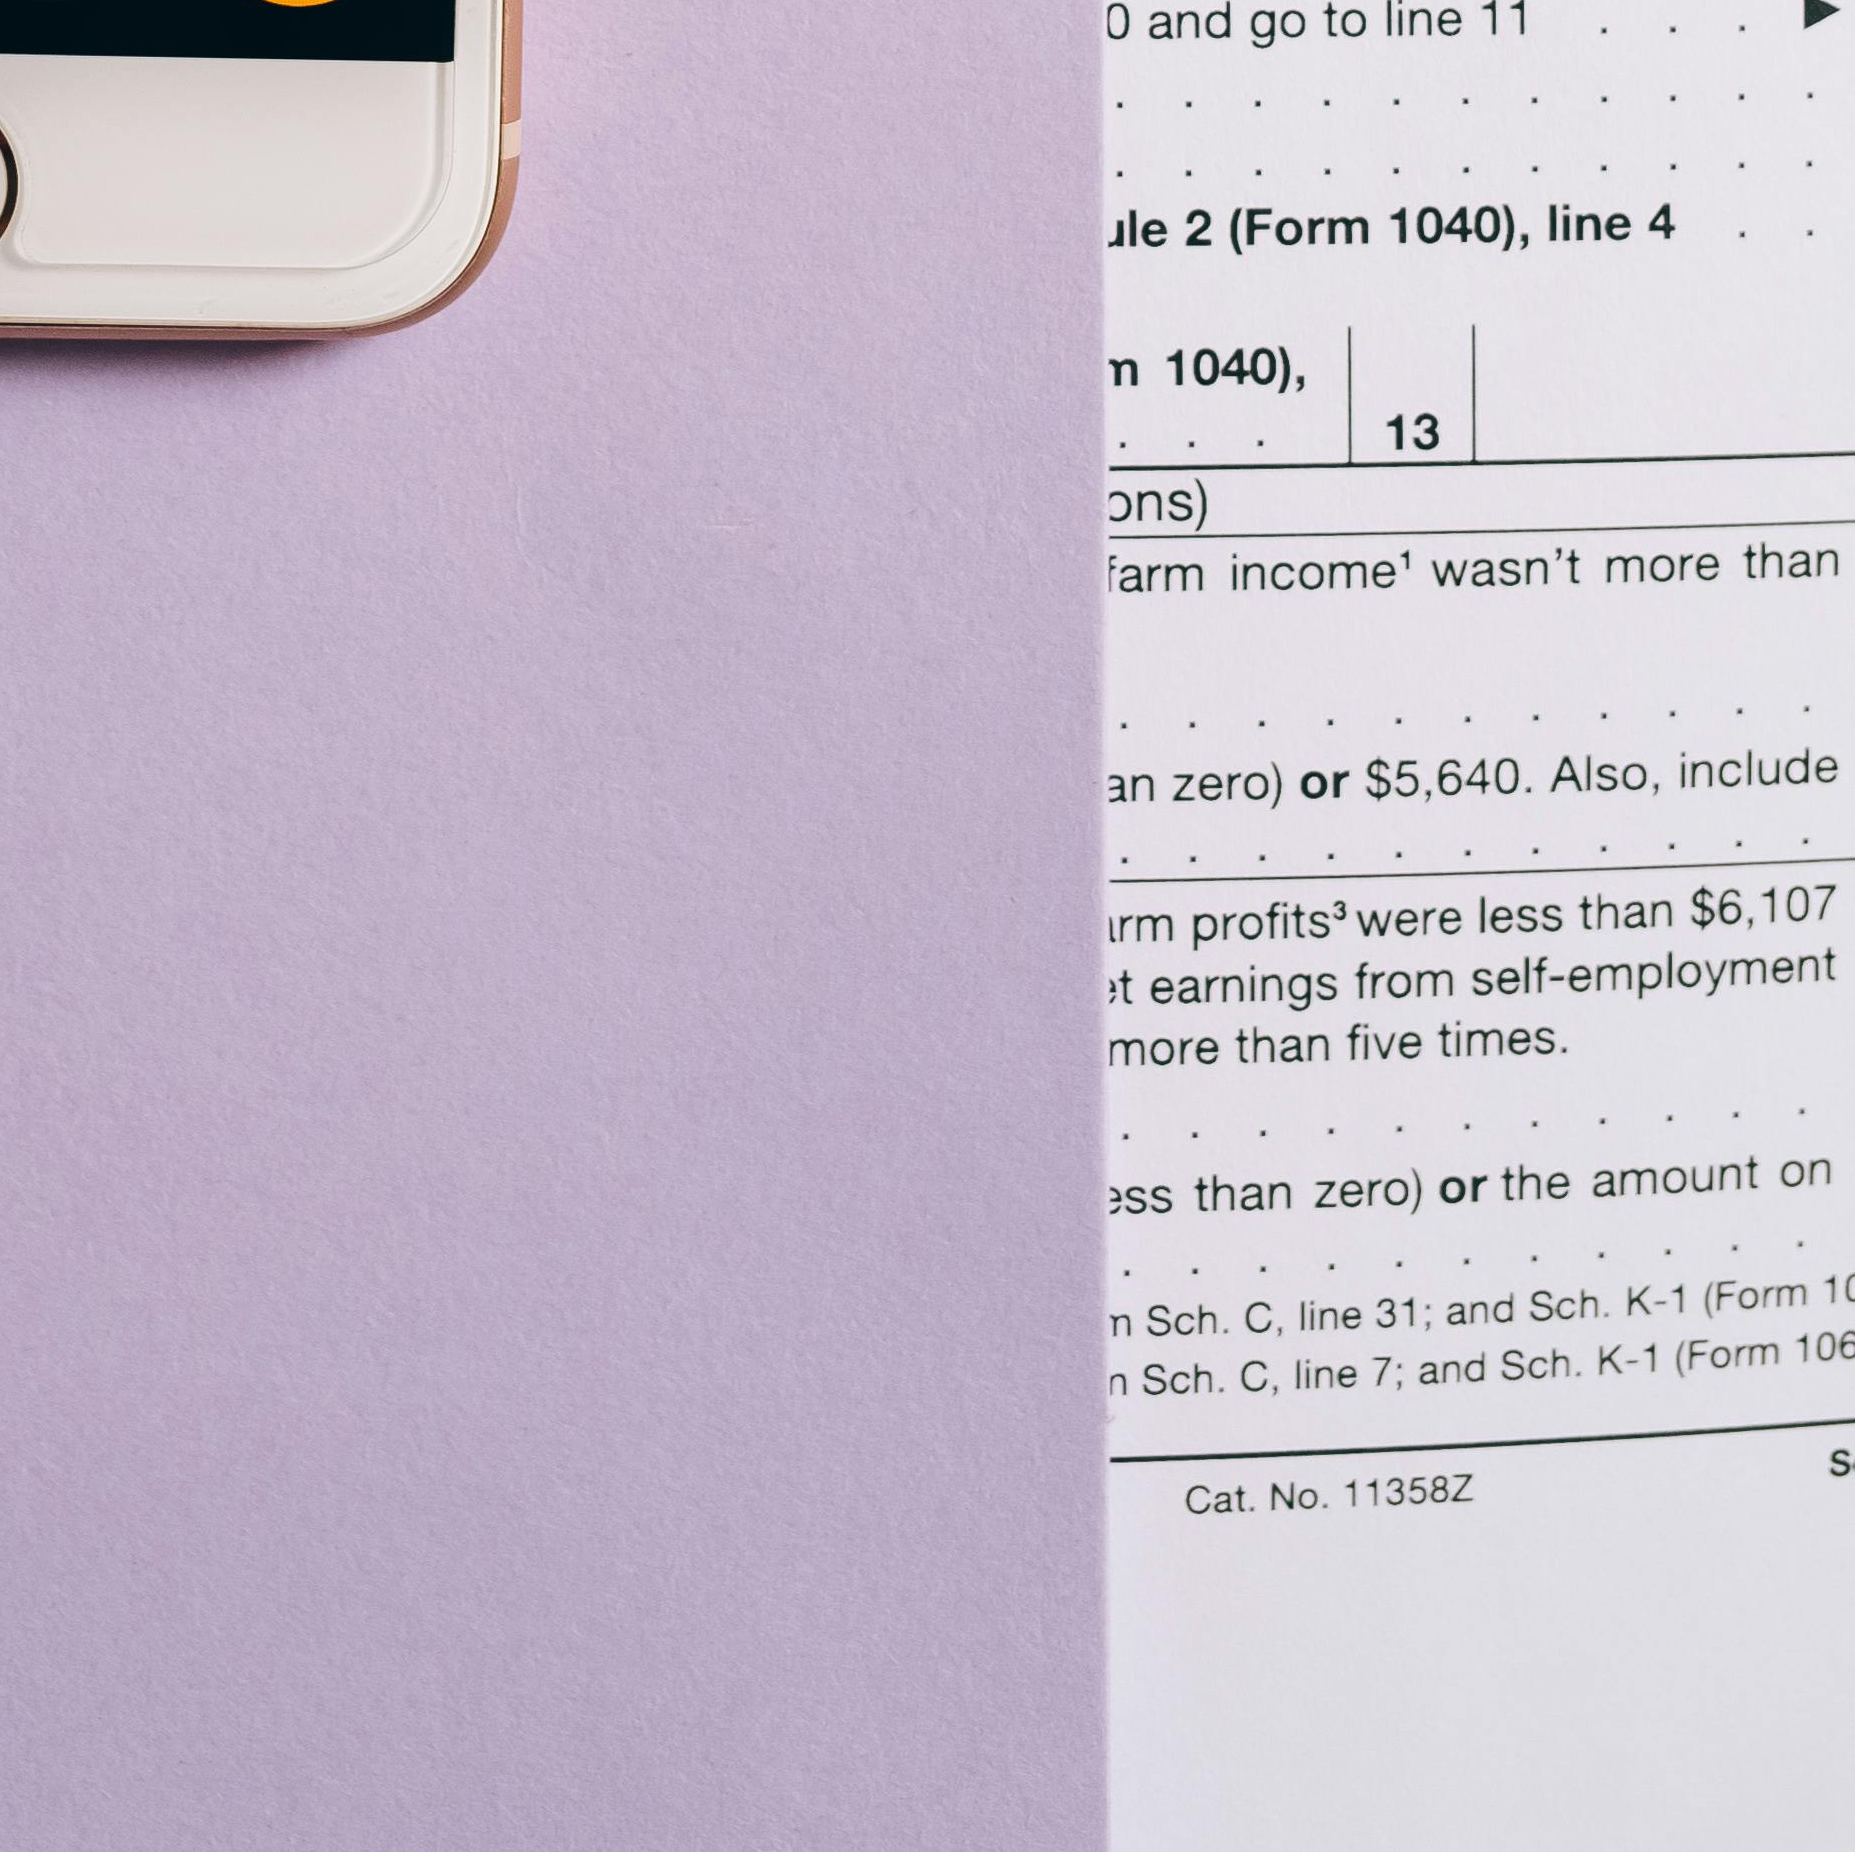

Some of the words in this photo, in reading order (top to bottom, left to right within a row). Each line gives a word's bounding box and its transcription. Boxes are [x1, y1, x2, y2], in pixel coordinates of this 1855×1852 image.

[1186, 209, 1211, 246] 2
[1230, 208, 1368, 255] (Form
[1391, 205, 1528, 251] 1040),
[1550, 204, 1631, 241] line
[1649, 204, 1675, 239] 4
[1387, 413, 1439, 450] 13
[1173, 763, 1282, 809] zero)
[1301, 771, 1349, 799] or
[1367, 758, 1531, 801] $5,640.
[1551, 756, 1658, 794] Also,
[1681, 749, 1838, 788] include
[1151, 965, 1337, 1011] earnings
[1355, 962, 1453, 999] from
[1473, 948, 1835, 999] self-employment
[1186, 1486, 1254, 1514] Cat.
[1272, 1483, 1328, 1510] No.
[1346, 1474, 1473, 1506] 11358Z
